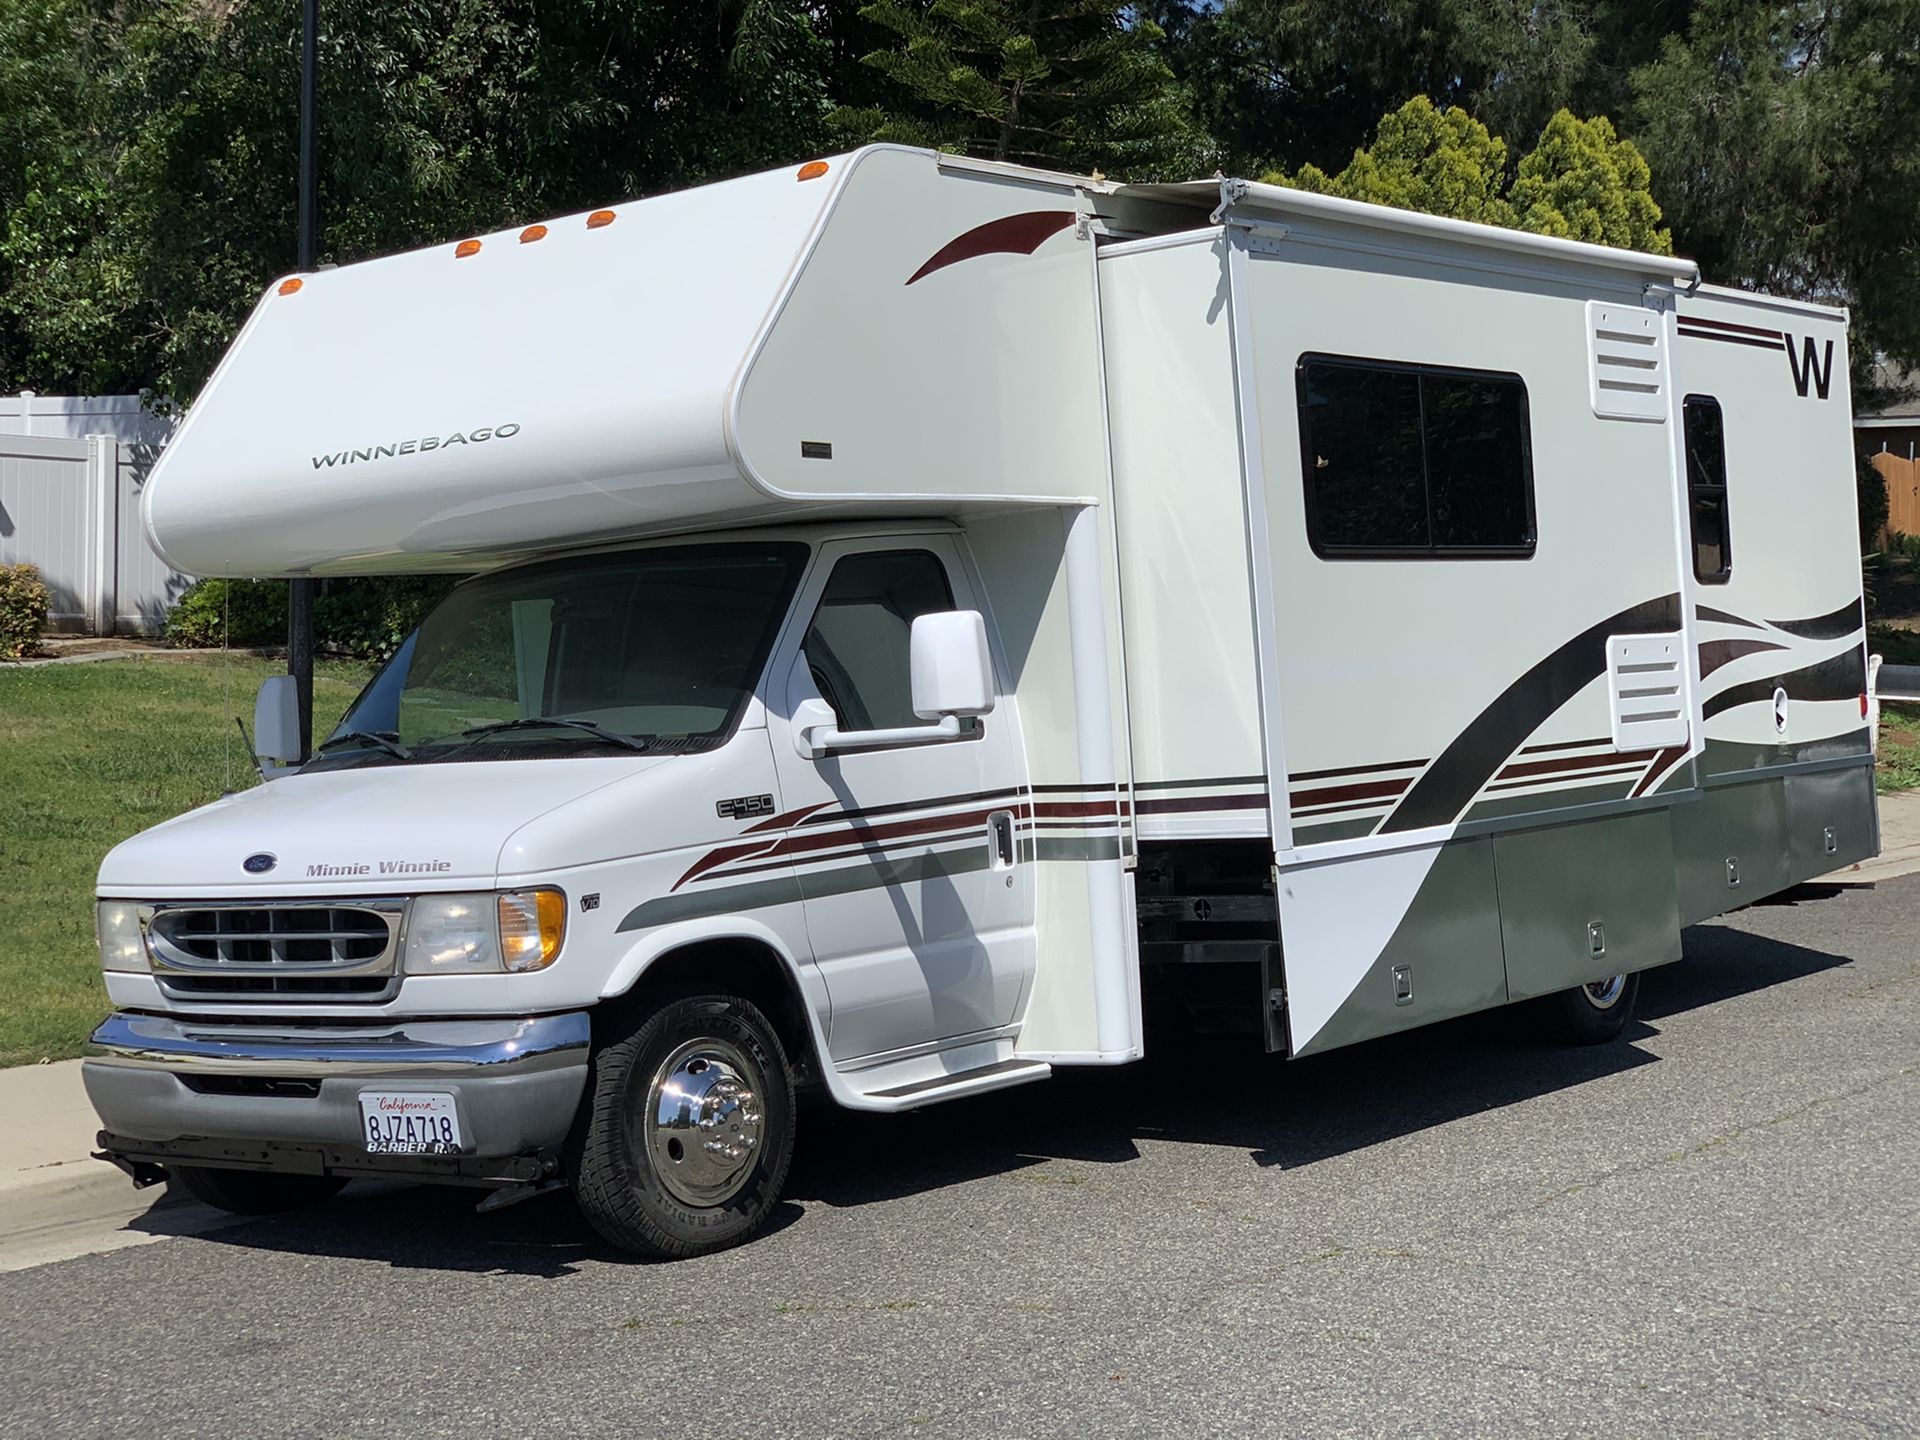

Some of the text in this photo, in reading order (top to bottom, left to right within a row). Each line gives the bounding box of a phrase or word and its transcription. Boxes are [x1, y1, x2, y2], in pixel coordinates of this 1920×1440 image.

[1784, 332, 1834, 400] W
[312, 423, 521, 470] WINNEBAGO
[306, 859, 452, 877] Minnie Winnie
[379, 1096, 438, 1114] California
[368, 1115, 453, 1143] 8JZA718
[367, 1141, 428, 1154] BARBER
